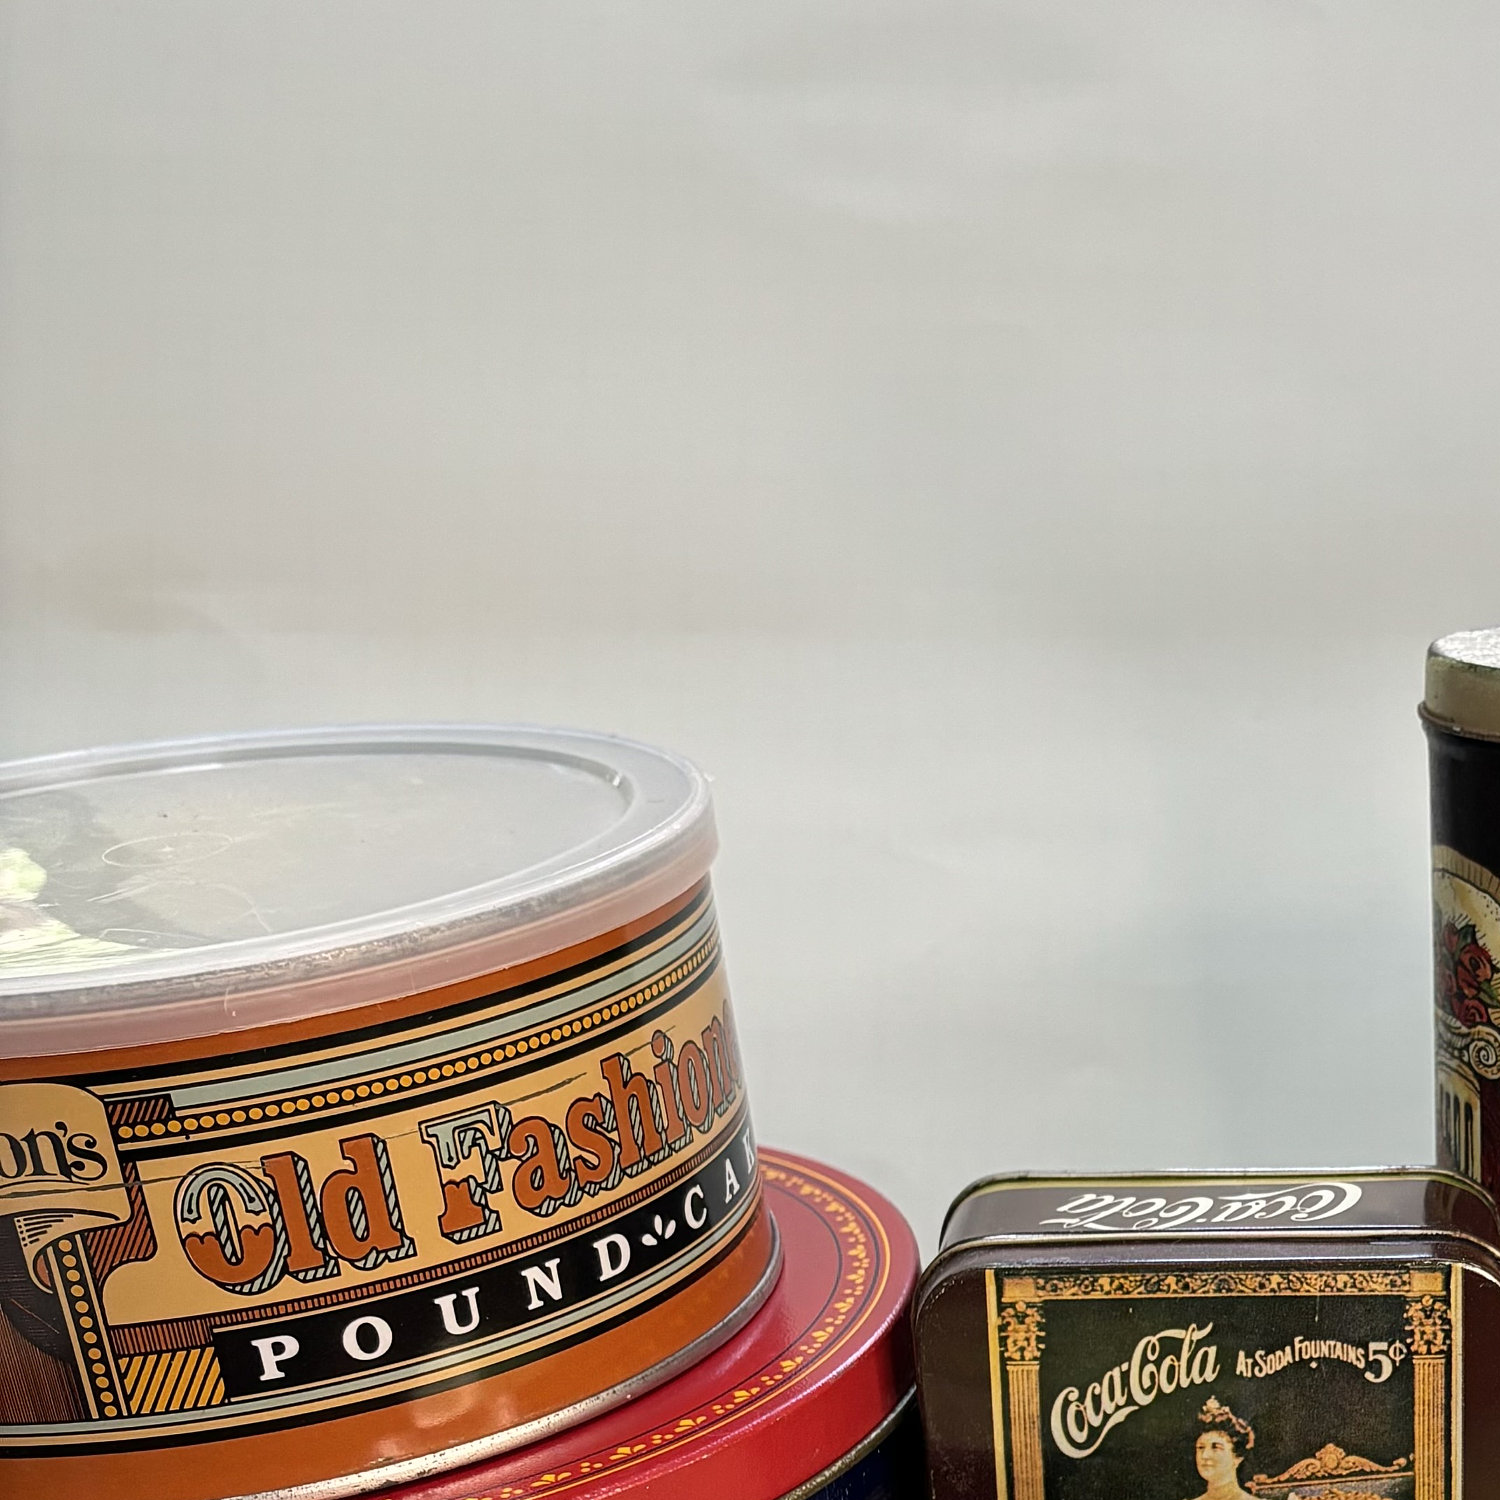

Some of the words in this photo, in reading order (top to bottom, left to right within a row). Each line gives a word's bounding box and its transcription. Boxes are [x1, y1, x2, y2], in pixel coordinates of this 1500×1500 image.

[174, 1134, 415, 1297] Old
[420, 998, 744, 1242] Fashion
[250, 1233, 632, 1382] POUND
[1050, 1322, 1221, 1460] Coca-Cola
